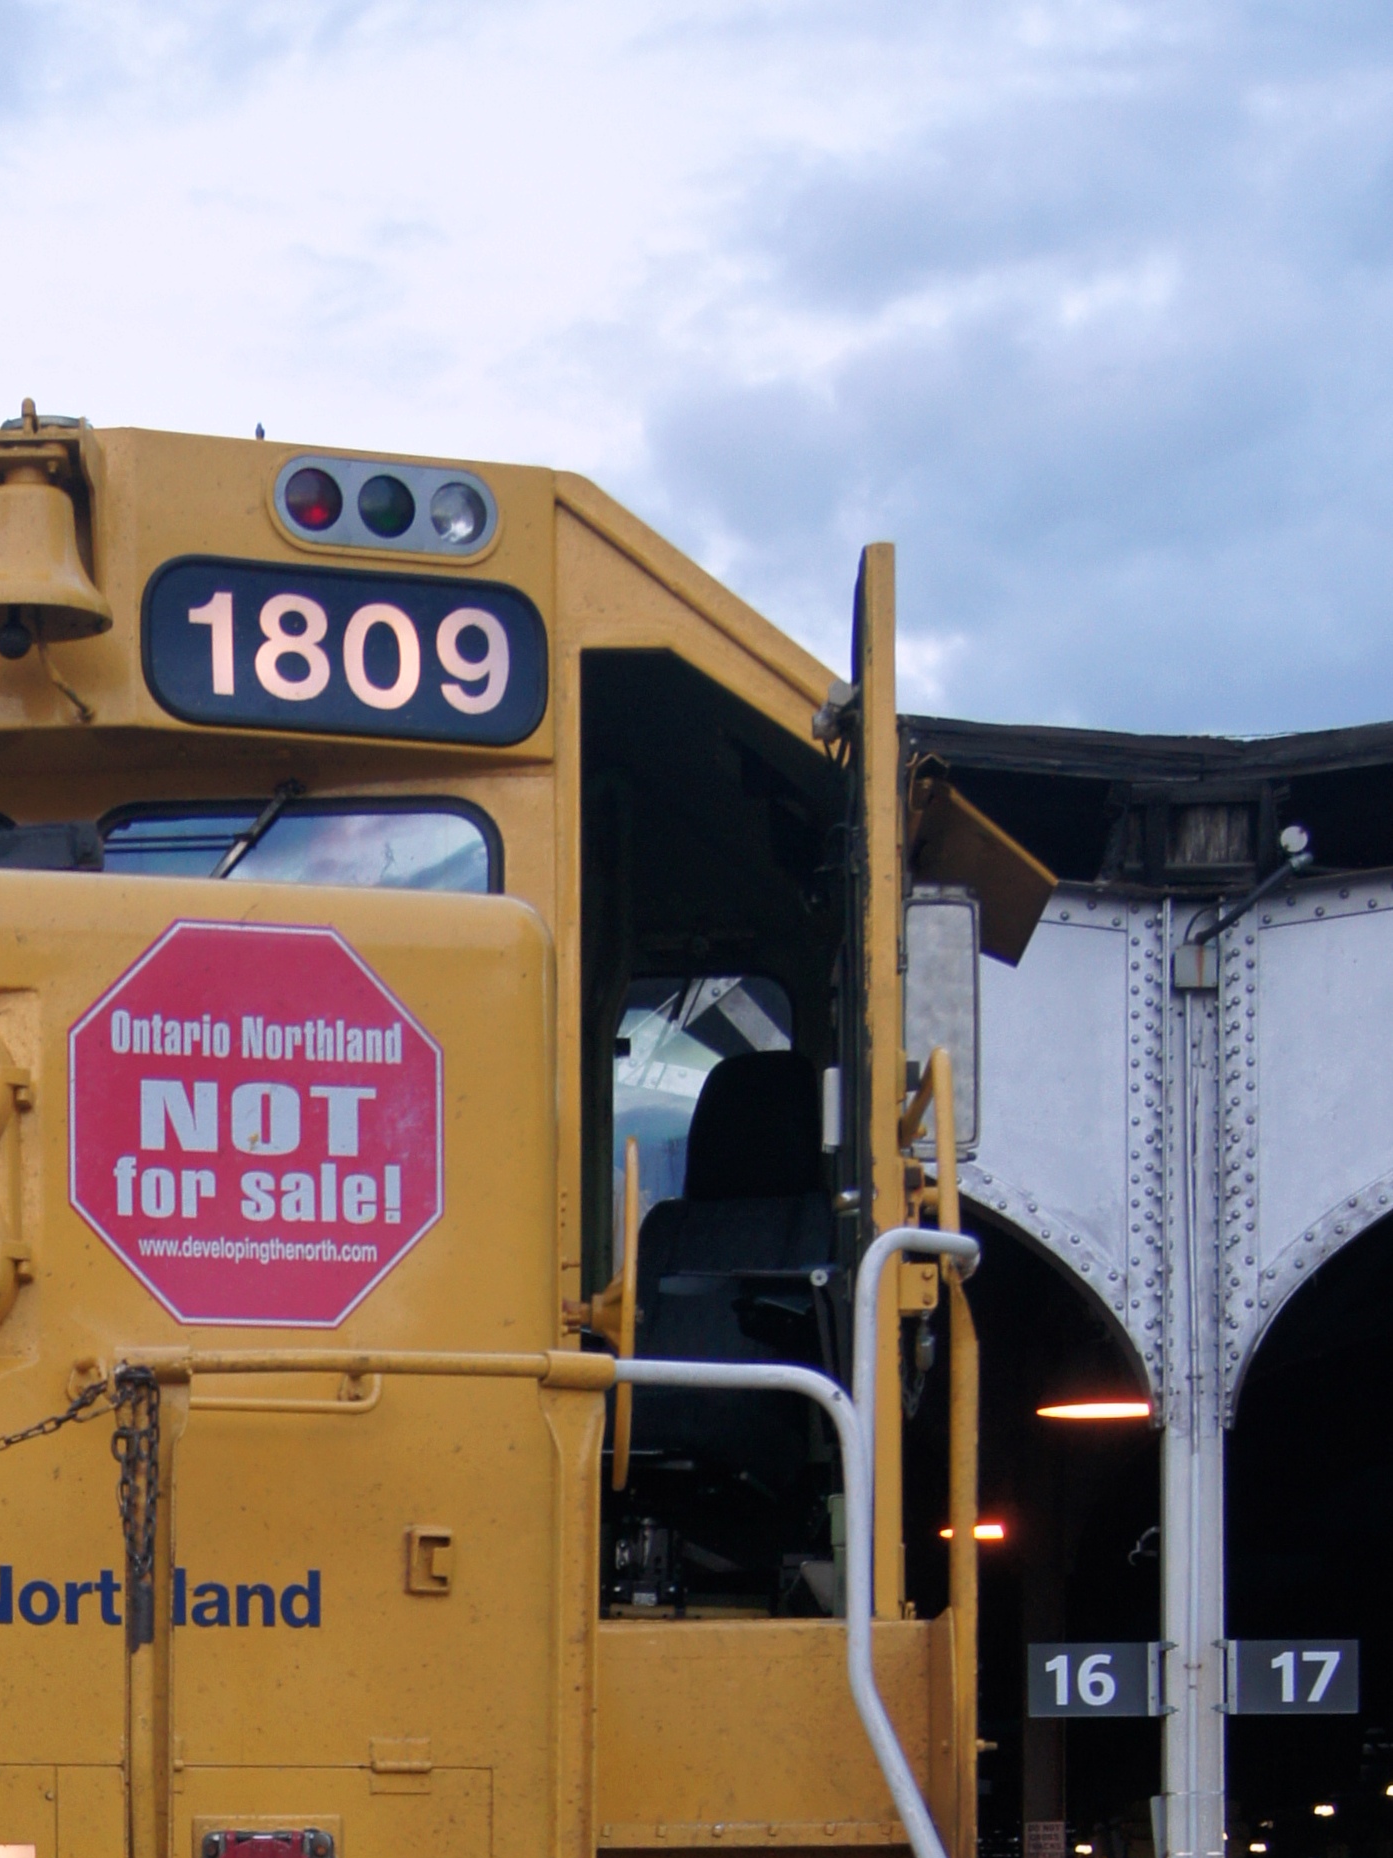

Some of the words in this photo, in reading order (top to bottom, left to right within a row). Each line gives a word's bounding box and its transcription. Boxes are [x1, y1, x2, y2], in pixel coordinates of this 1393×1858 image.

[188, 591, 510, 715] 1809
[111, 1009, 231, 1059] Ontario
[241, 1015, 403, 1065] Northland
[139, 1078, 377, 1157] NOT
[112, 1155, 216, 1219] for
[239, 1161, 402, 1225] sale!
[137, 1235, 378, 1265] www.developingthenorth.com
[1044, 1653, 1117, 1706] 16
[1270, 1650, 1341, 1703] 17
